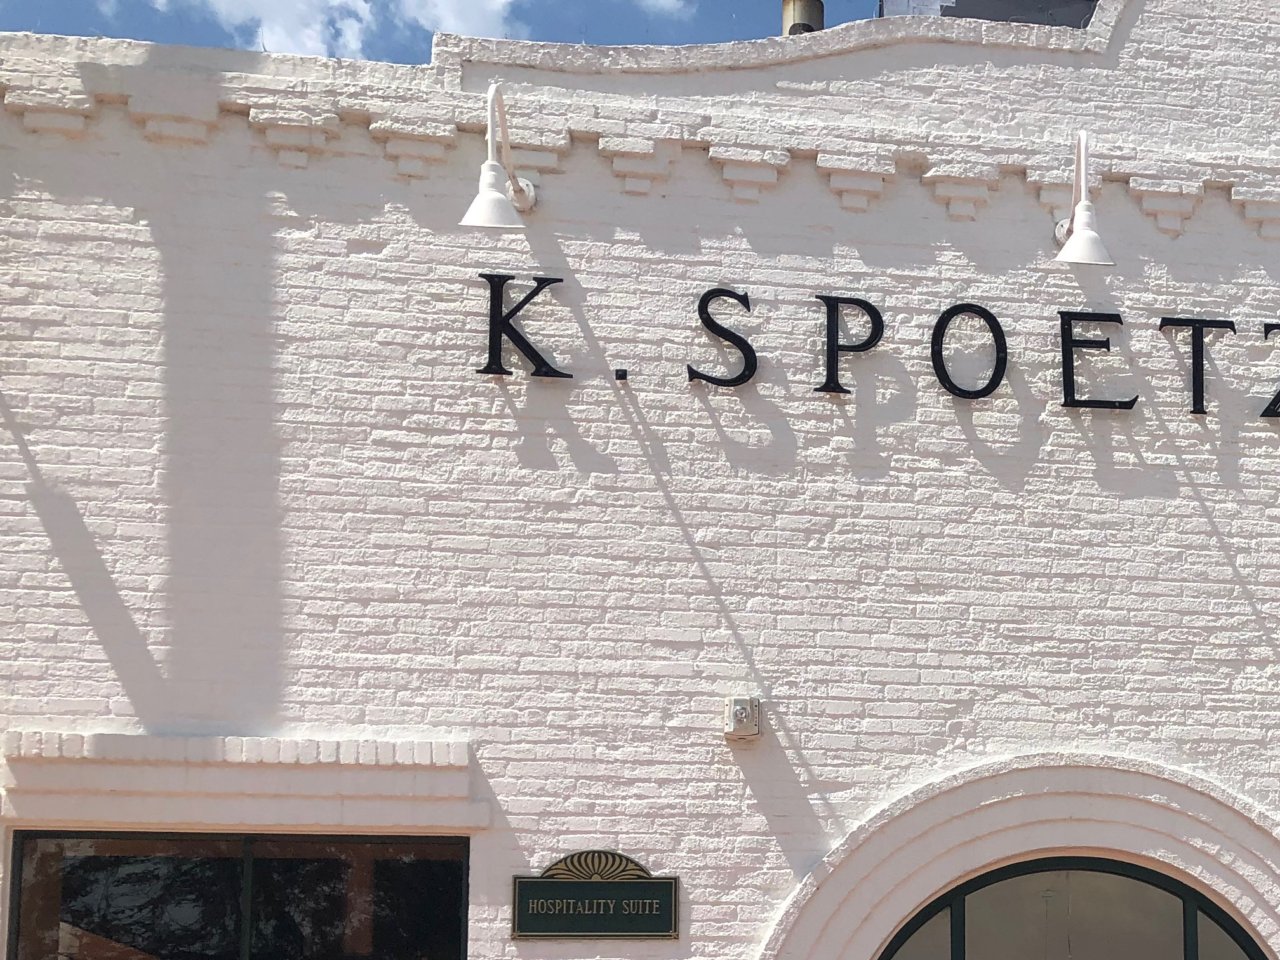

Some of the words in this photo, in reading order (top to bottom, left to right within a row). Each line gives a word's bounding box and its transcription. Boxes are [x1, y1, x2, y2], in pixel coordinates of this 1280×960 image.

[475, 273, 628, 381] K.
[528, 899, 616, 914] HOSPITALITY
[622, 899, 661, 914] SUITE
